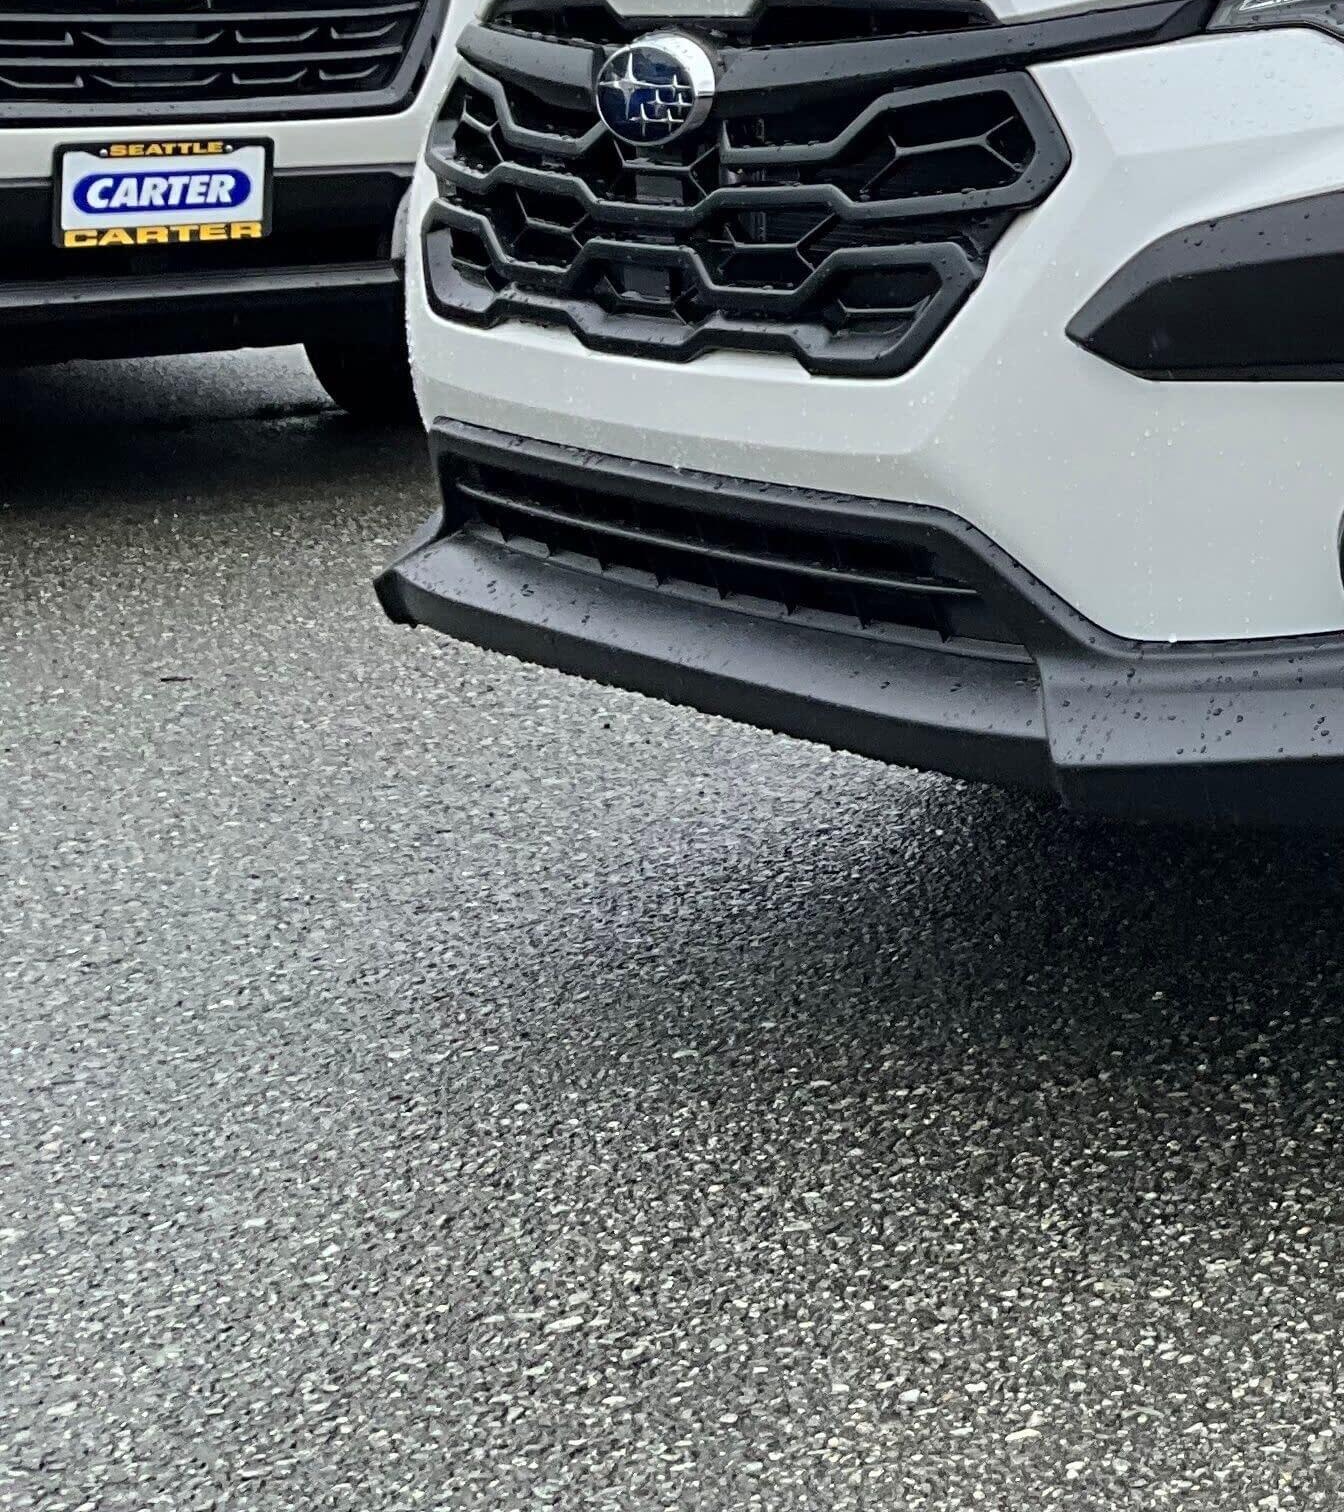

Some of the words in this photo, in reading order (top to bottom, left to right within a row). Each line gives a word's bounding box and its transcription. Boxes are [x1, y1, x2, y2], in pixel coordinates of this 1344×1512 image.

[109, 141, 223, 157] SEATTLE
[86, 174, 236, 209] CARTER
[64, 222, 262, 248] CARTER
